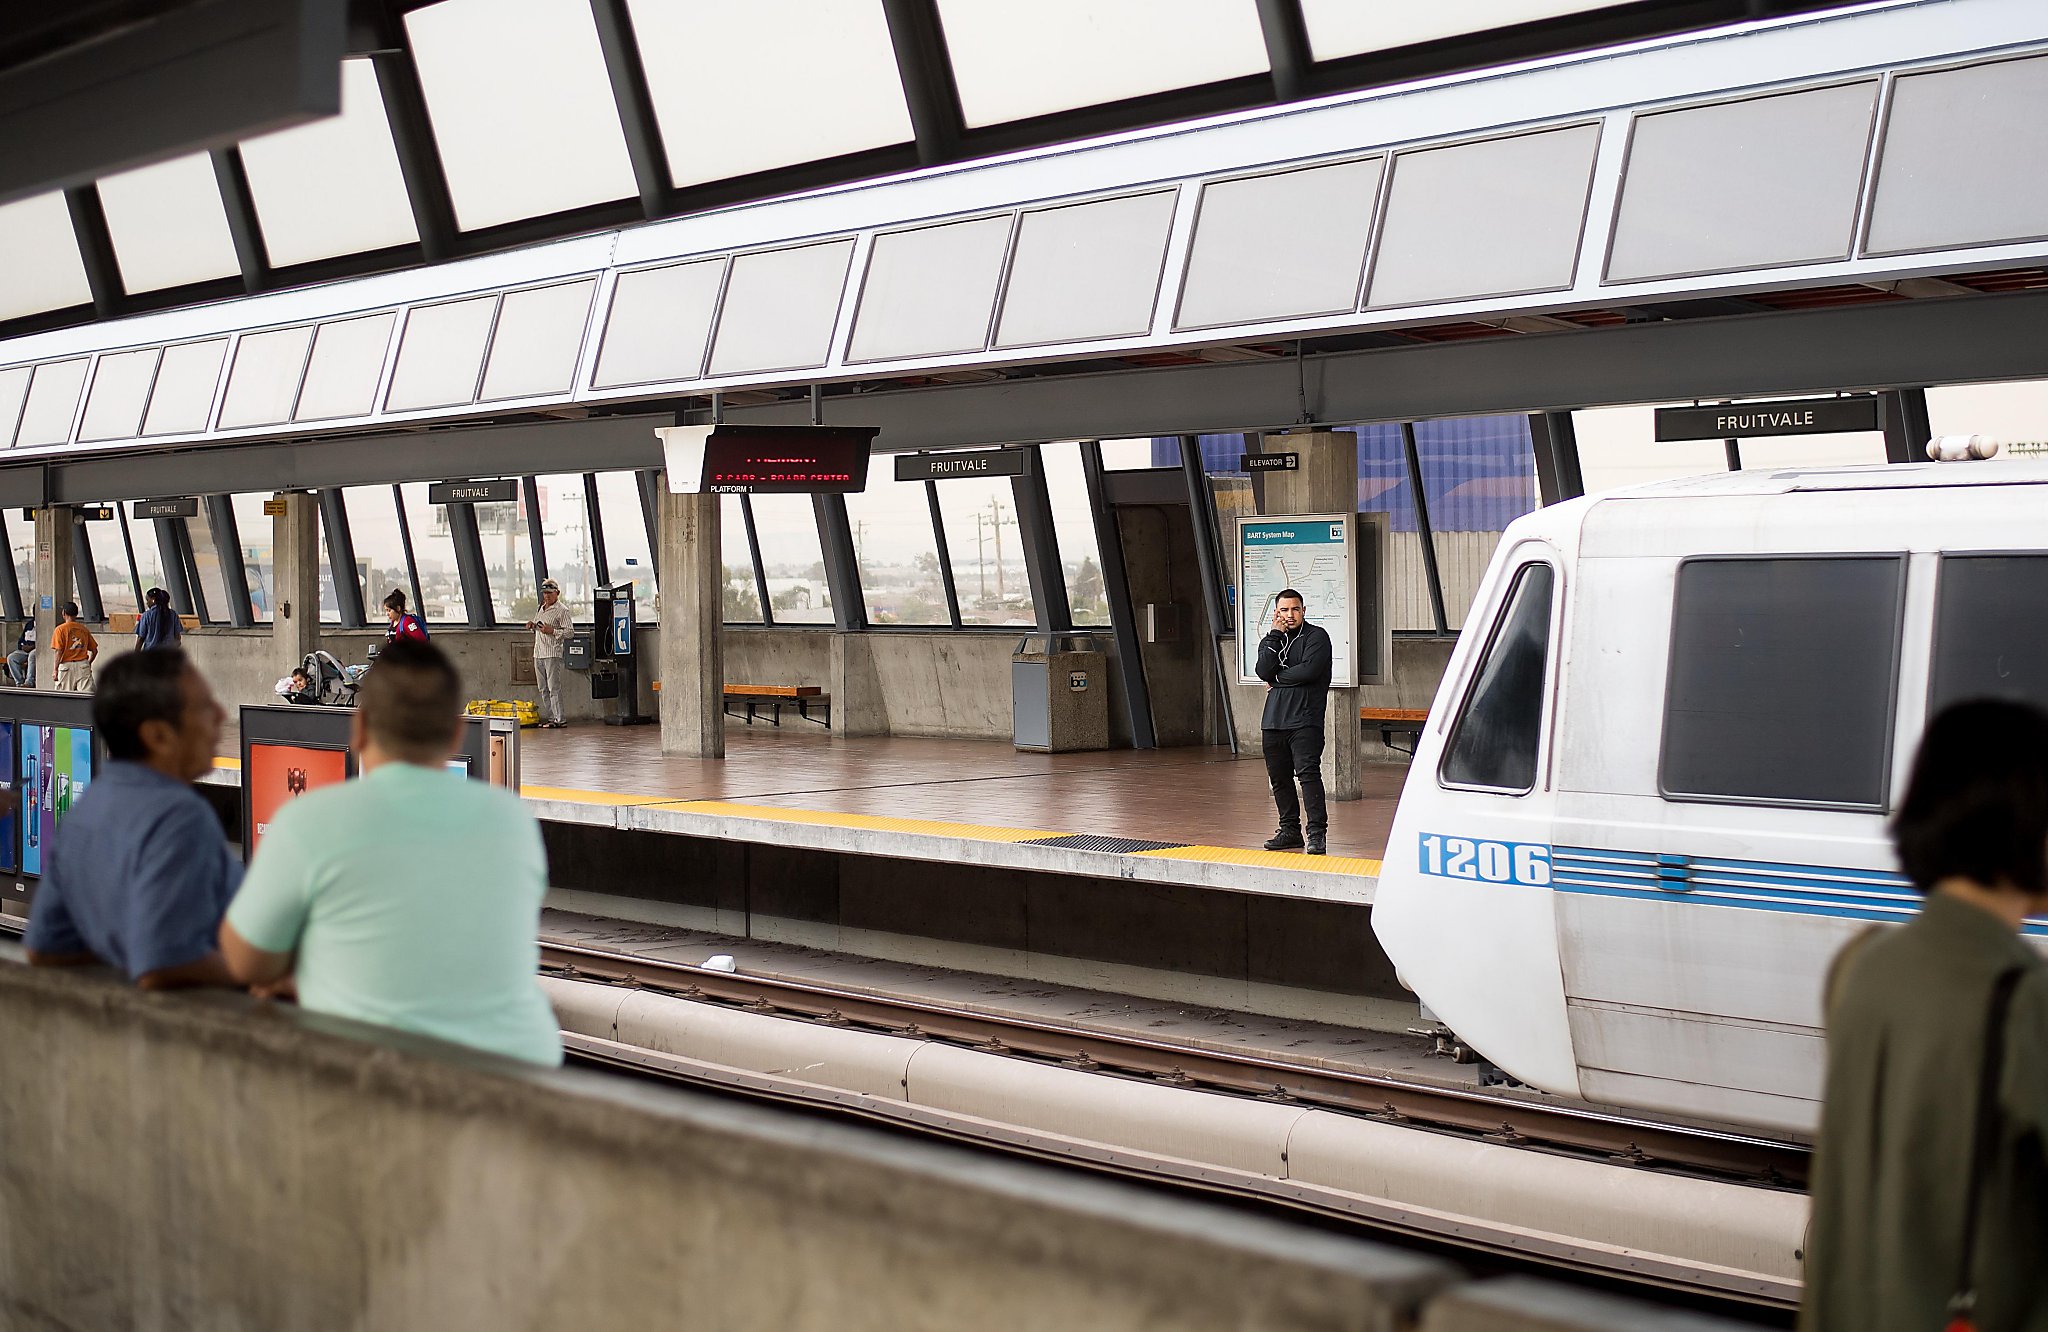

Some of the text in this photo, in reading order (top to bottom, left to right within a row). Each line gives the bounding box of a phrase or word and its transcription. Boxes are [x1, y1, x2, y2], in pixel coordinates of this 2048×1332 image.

[1717, 411, 1814, 430] FRUITVALE
[930, 459, 987, 473] FRUITVALE
[1249, 459, 1283, 467] ELEVATOR
[452, 487, 489, 498] FRUITVALE
[710, 485, 754, 493] PLATFORM 1
[150, 505, 177, 514] FRUITVALE
[1262, 531, 1281, 540] System
[1282, 530, 1295, 539] Map
[1422, 835, 1550, 885] 1206
